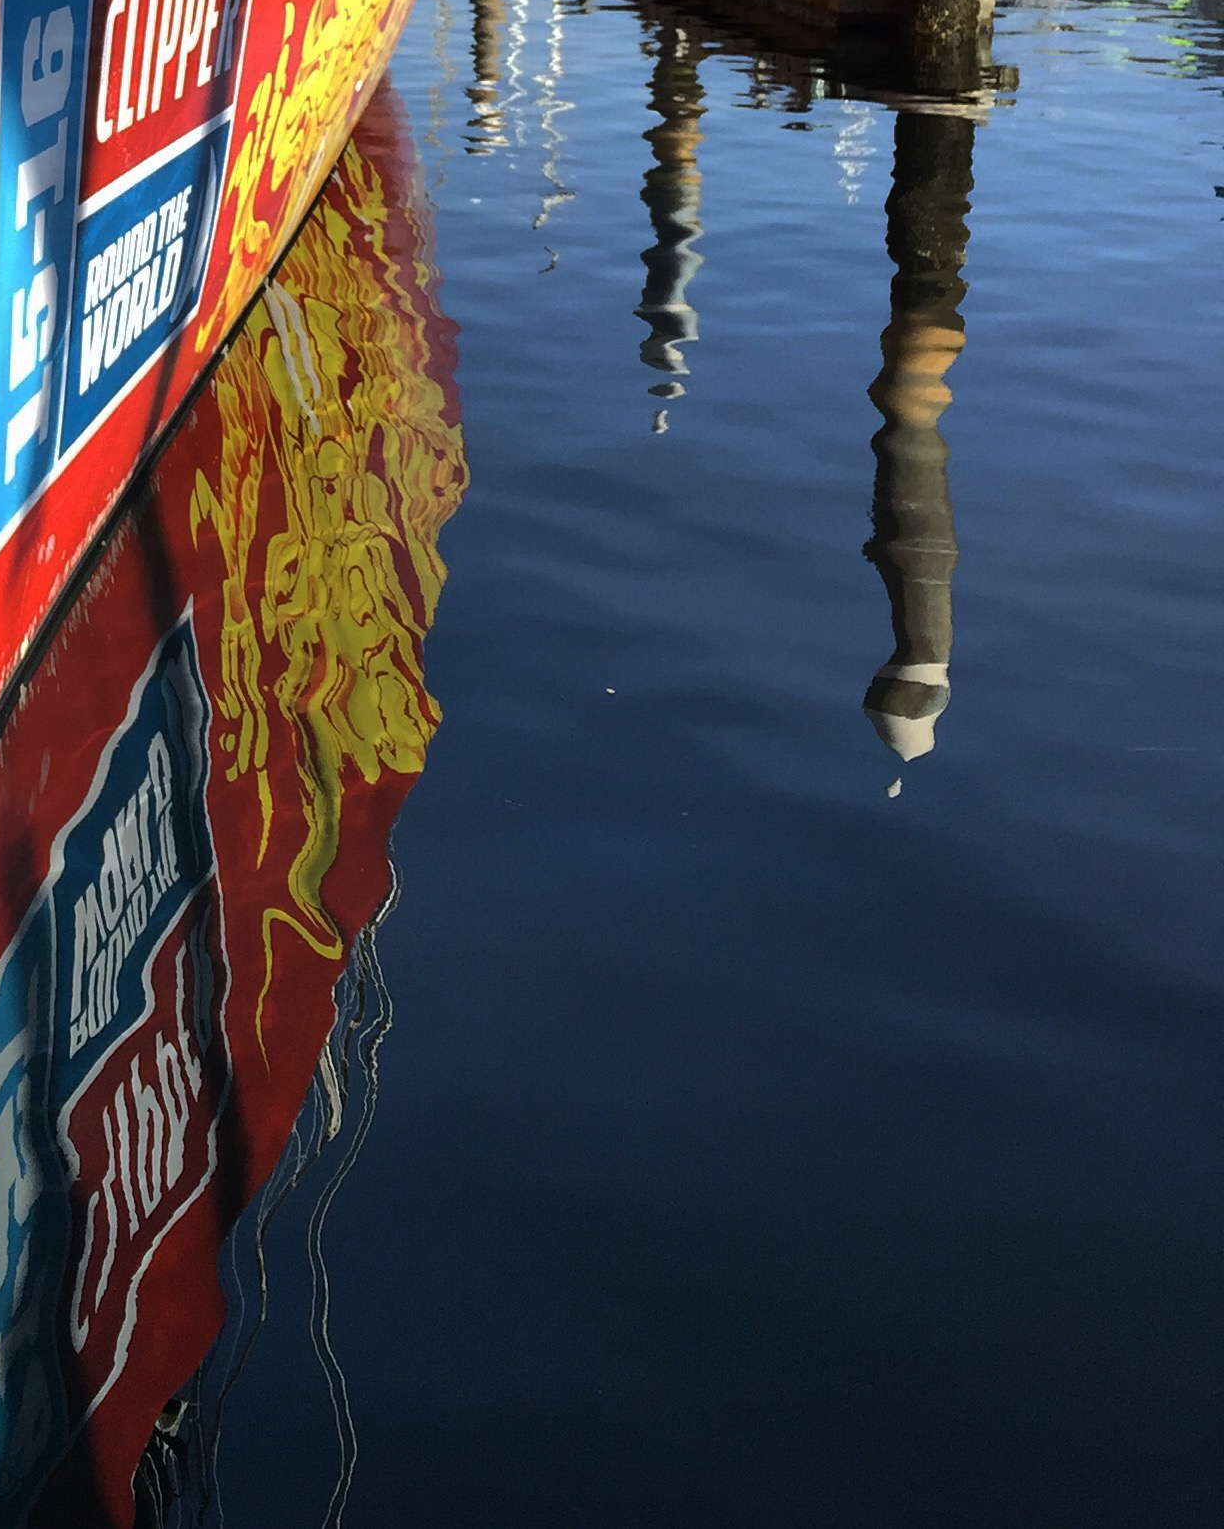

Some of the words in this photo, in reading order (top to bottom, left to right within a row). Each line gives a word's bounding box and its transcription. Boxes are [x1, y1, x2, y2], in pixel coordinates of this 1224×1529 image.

[5, 5, 75, 484] 15-16
[78, 236, 184, 397] WORLD
[83, 208, 157, 315] ROUND
[156, 185, 192, 248] THE
